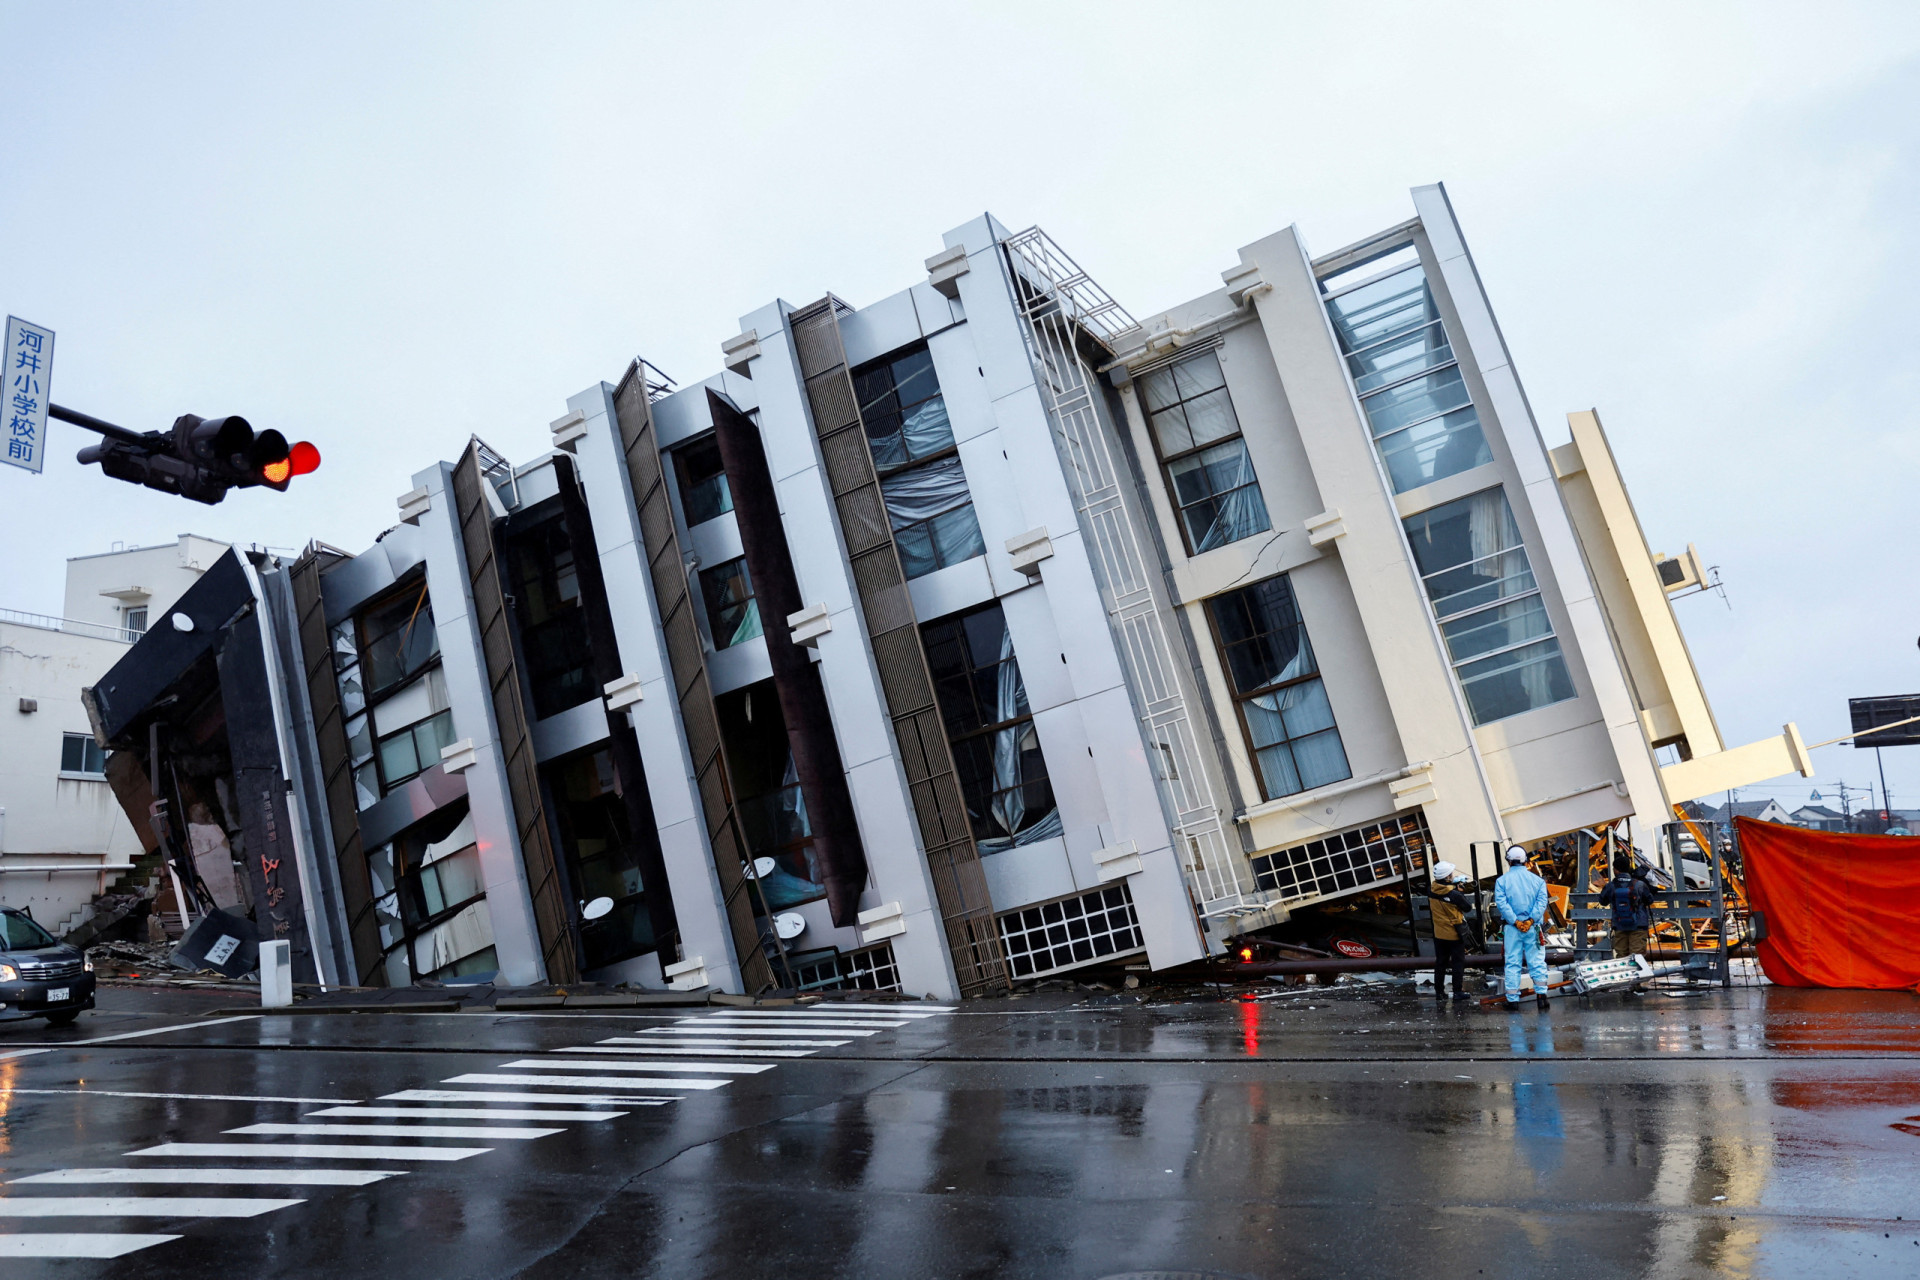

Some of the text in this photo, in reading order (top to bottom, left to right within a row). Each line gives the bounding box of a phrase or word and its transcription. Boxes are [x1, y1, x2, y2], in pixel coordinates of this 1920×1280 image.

[8, 327, 45, 463] 河井小学校前
